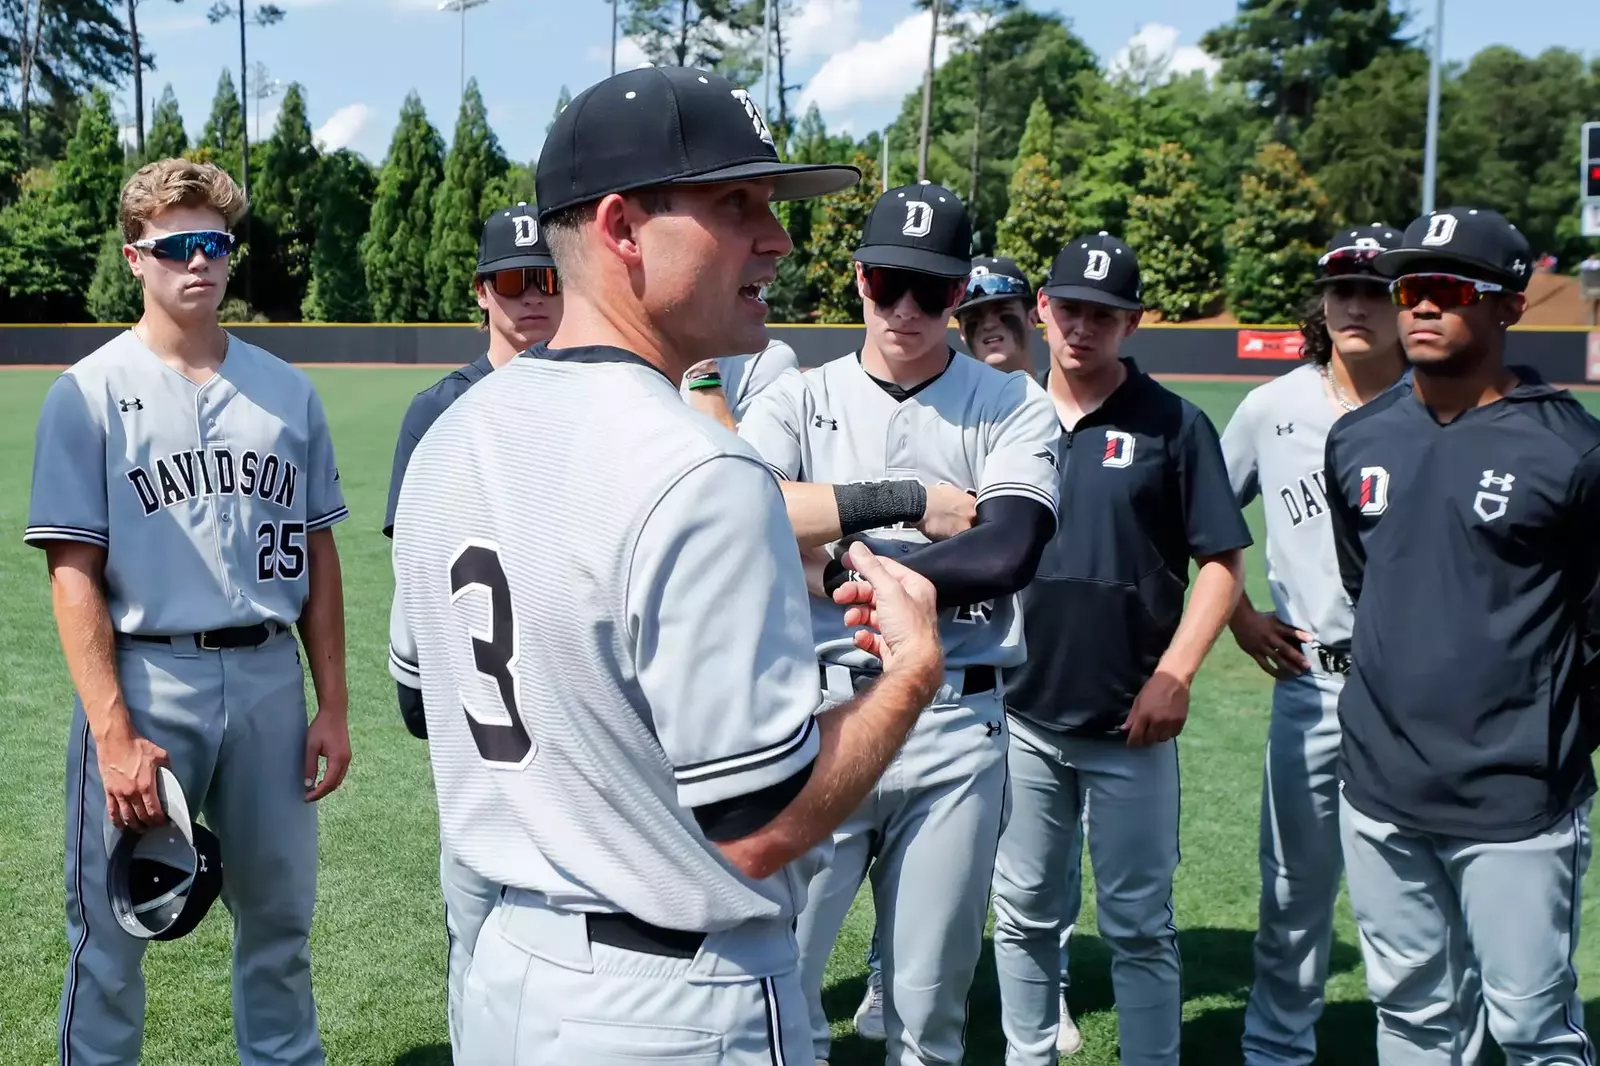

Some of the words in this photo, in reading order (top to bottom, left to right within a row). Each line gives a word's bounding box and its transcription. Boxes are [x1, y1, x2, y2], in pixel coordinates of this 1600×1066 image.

[512, 215, 538, 247] D
[903, 201, 933, 237] D
[1422, 214, 1458, 246] D
[1083, 250, 1111, 280] D
[1102, 430, 1136, 469] D
[125, 449, 298, 517] DAVIDSON
[1359, 466, 1390, 516] D
[256, 520, 307, 583] 25
[448, 537, 538, 771] 3
